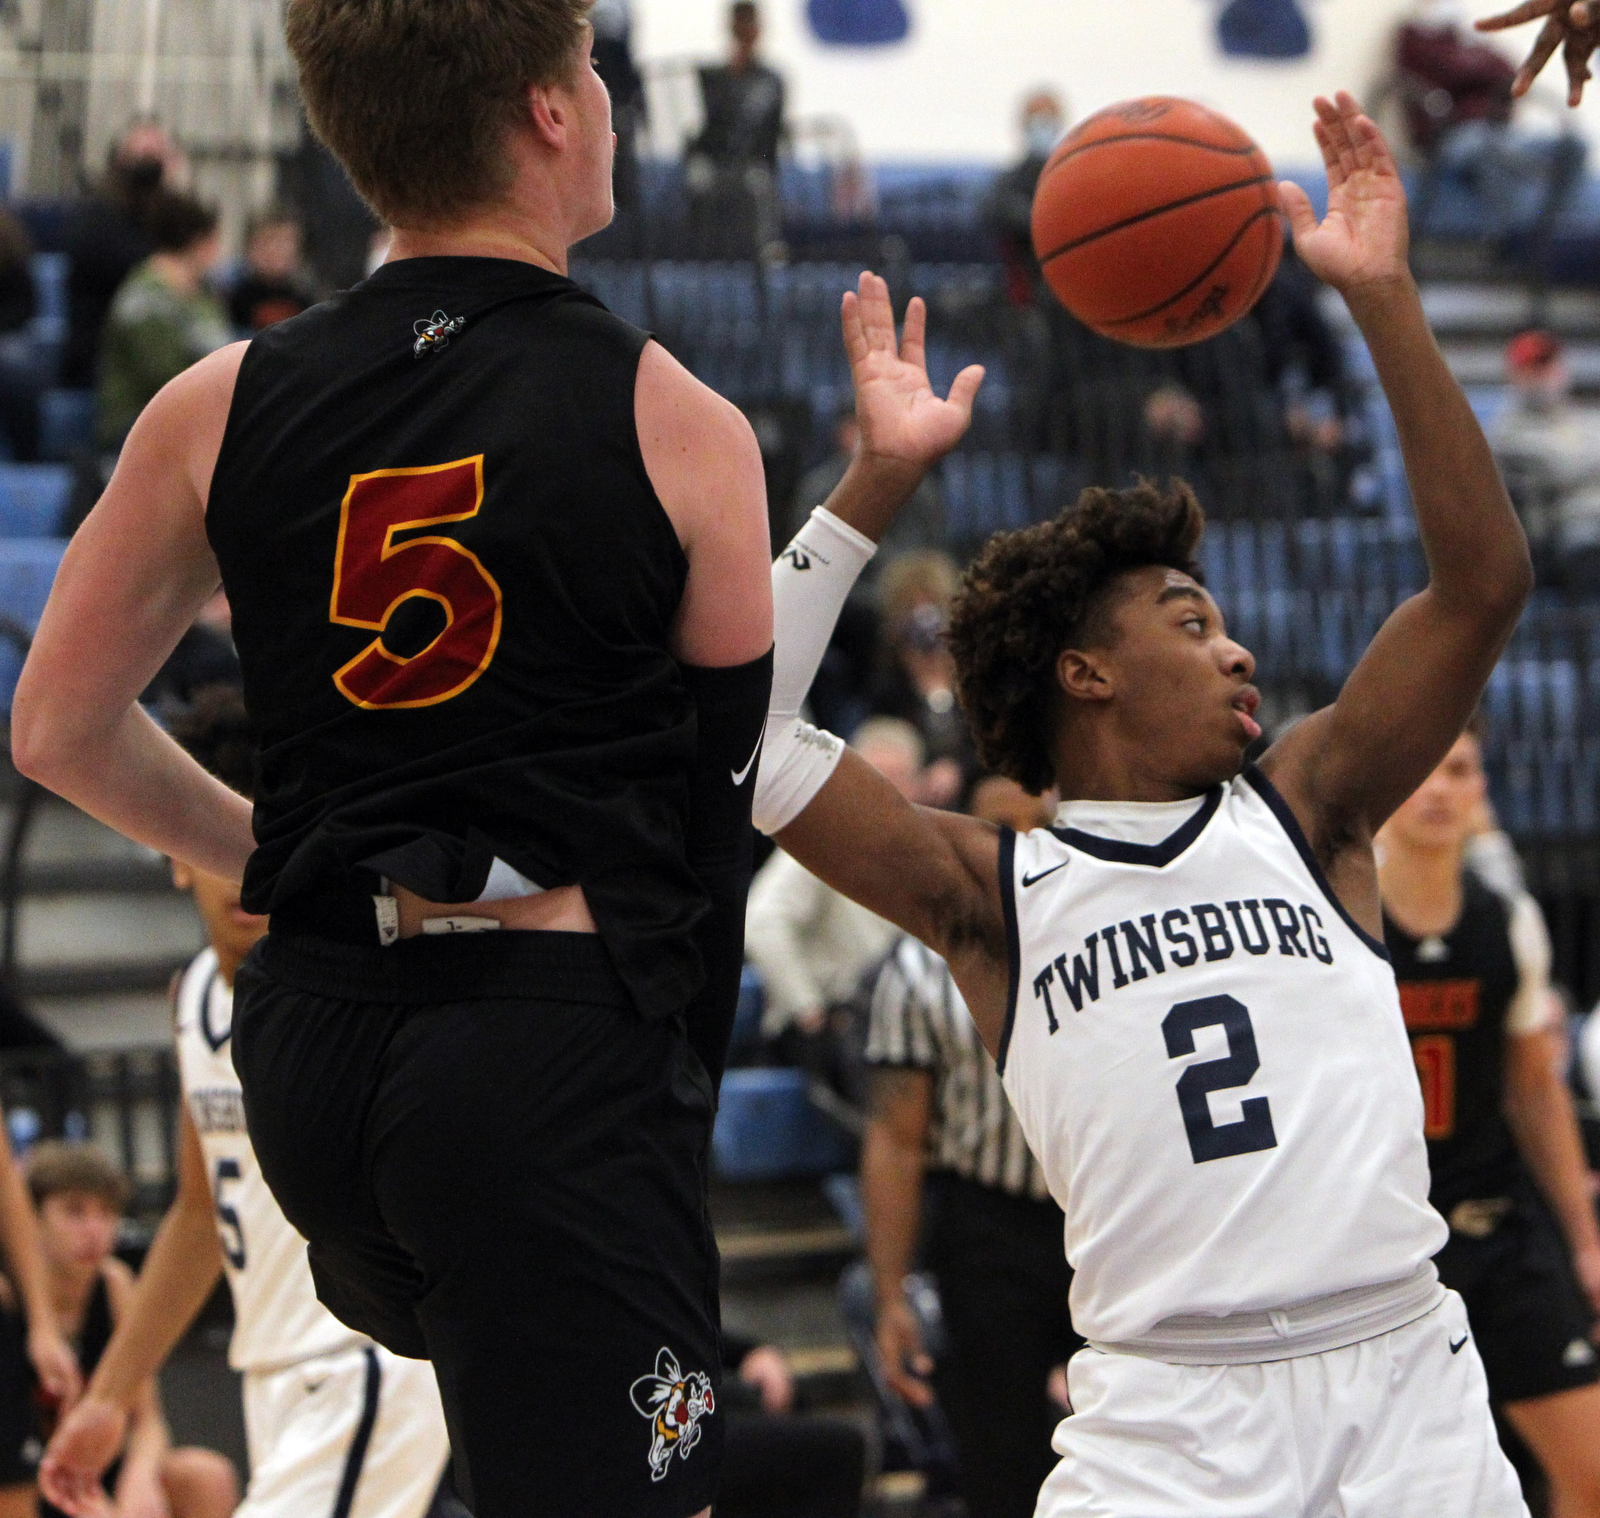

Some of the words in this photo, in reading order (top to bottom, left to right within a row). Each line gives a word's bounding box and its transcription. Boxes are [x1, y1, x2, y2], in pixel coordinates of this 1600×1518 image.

[329, 453, 502, 710] 5
[1033, 898, 1334, 1036] TWINSBURG
[1160, 993, 1278, 1164] 2
